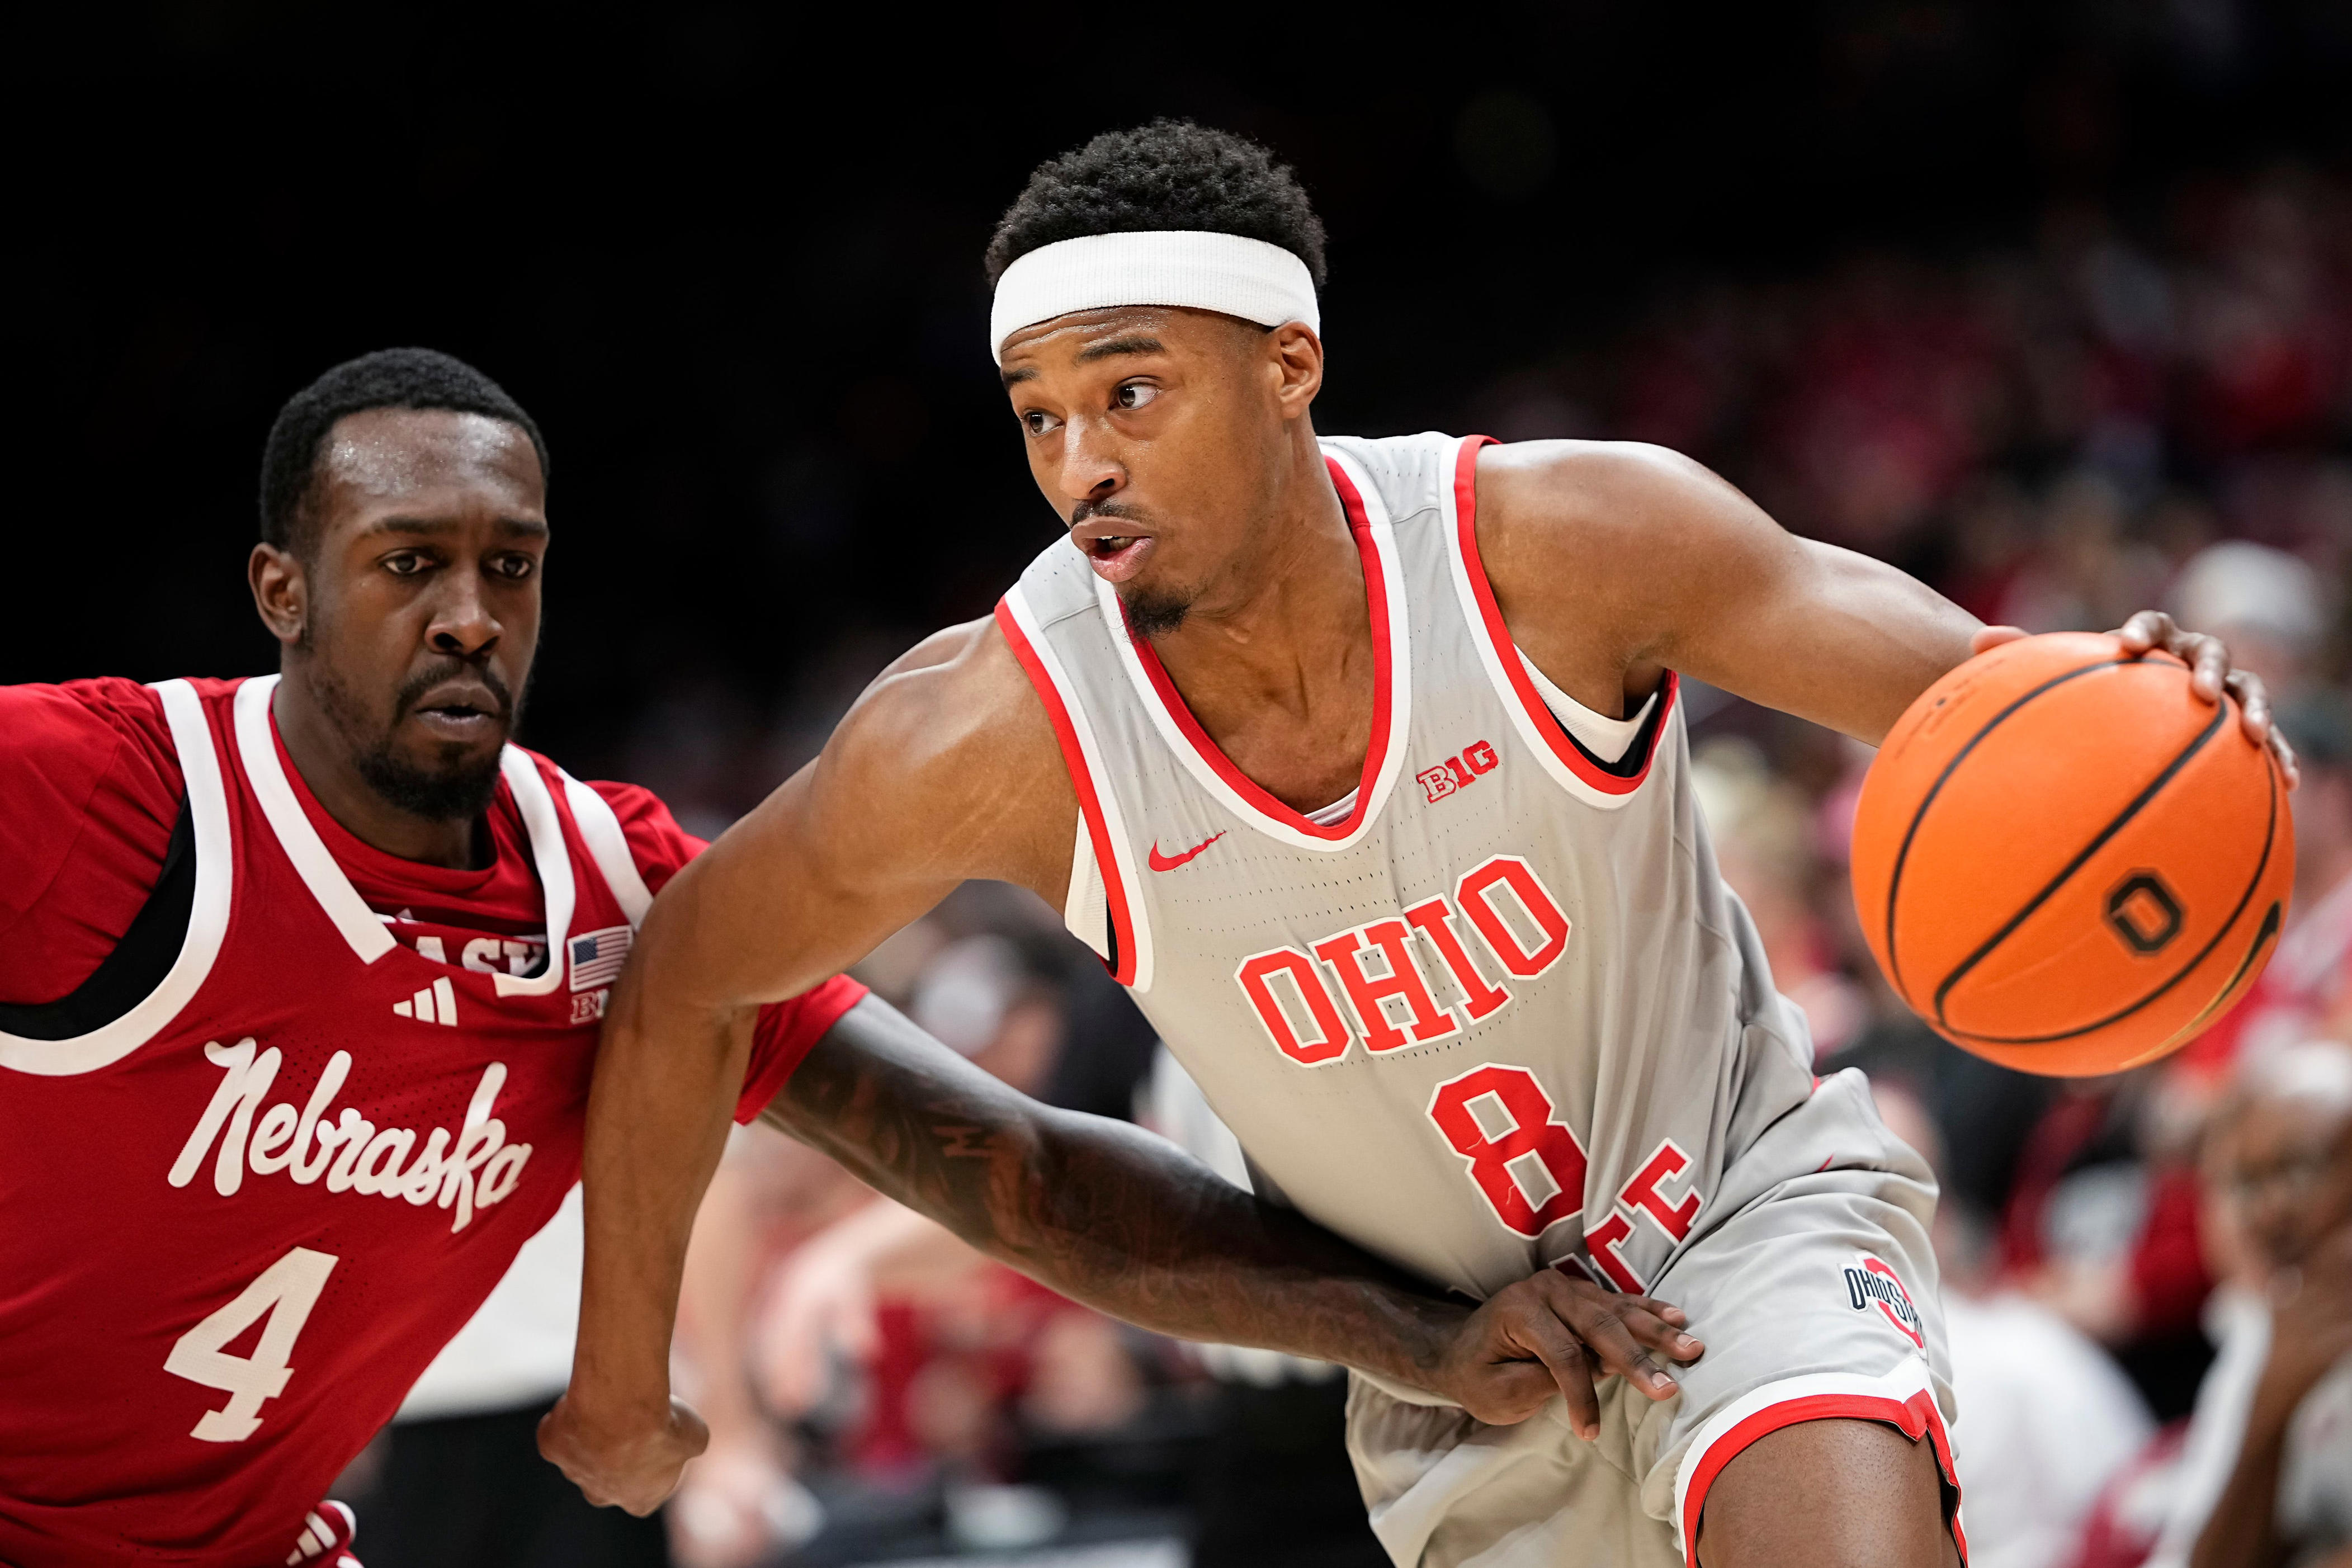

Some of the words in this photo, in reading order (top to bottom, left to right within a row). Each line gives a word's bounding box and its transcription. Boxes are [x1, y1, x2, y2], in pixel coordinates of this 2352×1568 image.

[1416, 740, 1499, 804] BIG
[1234, 854, 1572, 1068] OHIO
[168, 1036, 533, 1233] Nebraska
[1425, 1062, 1588, 1241] 8
[163, 1246, 339, 1443] 4
